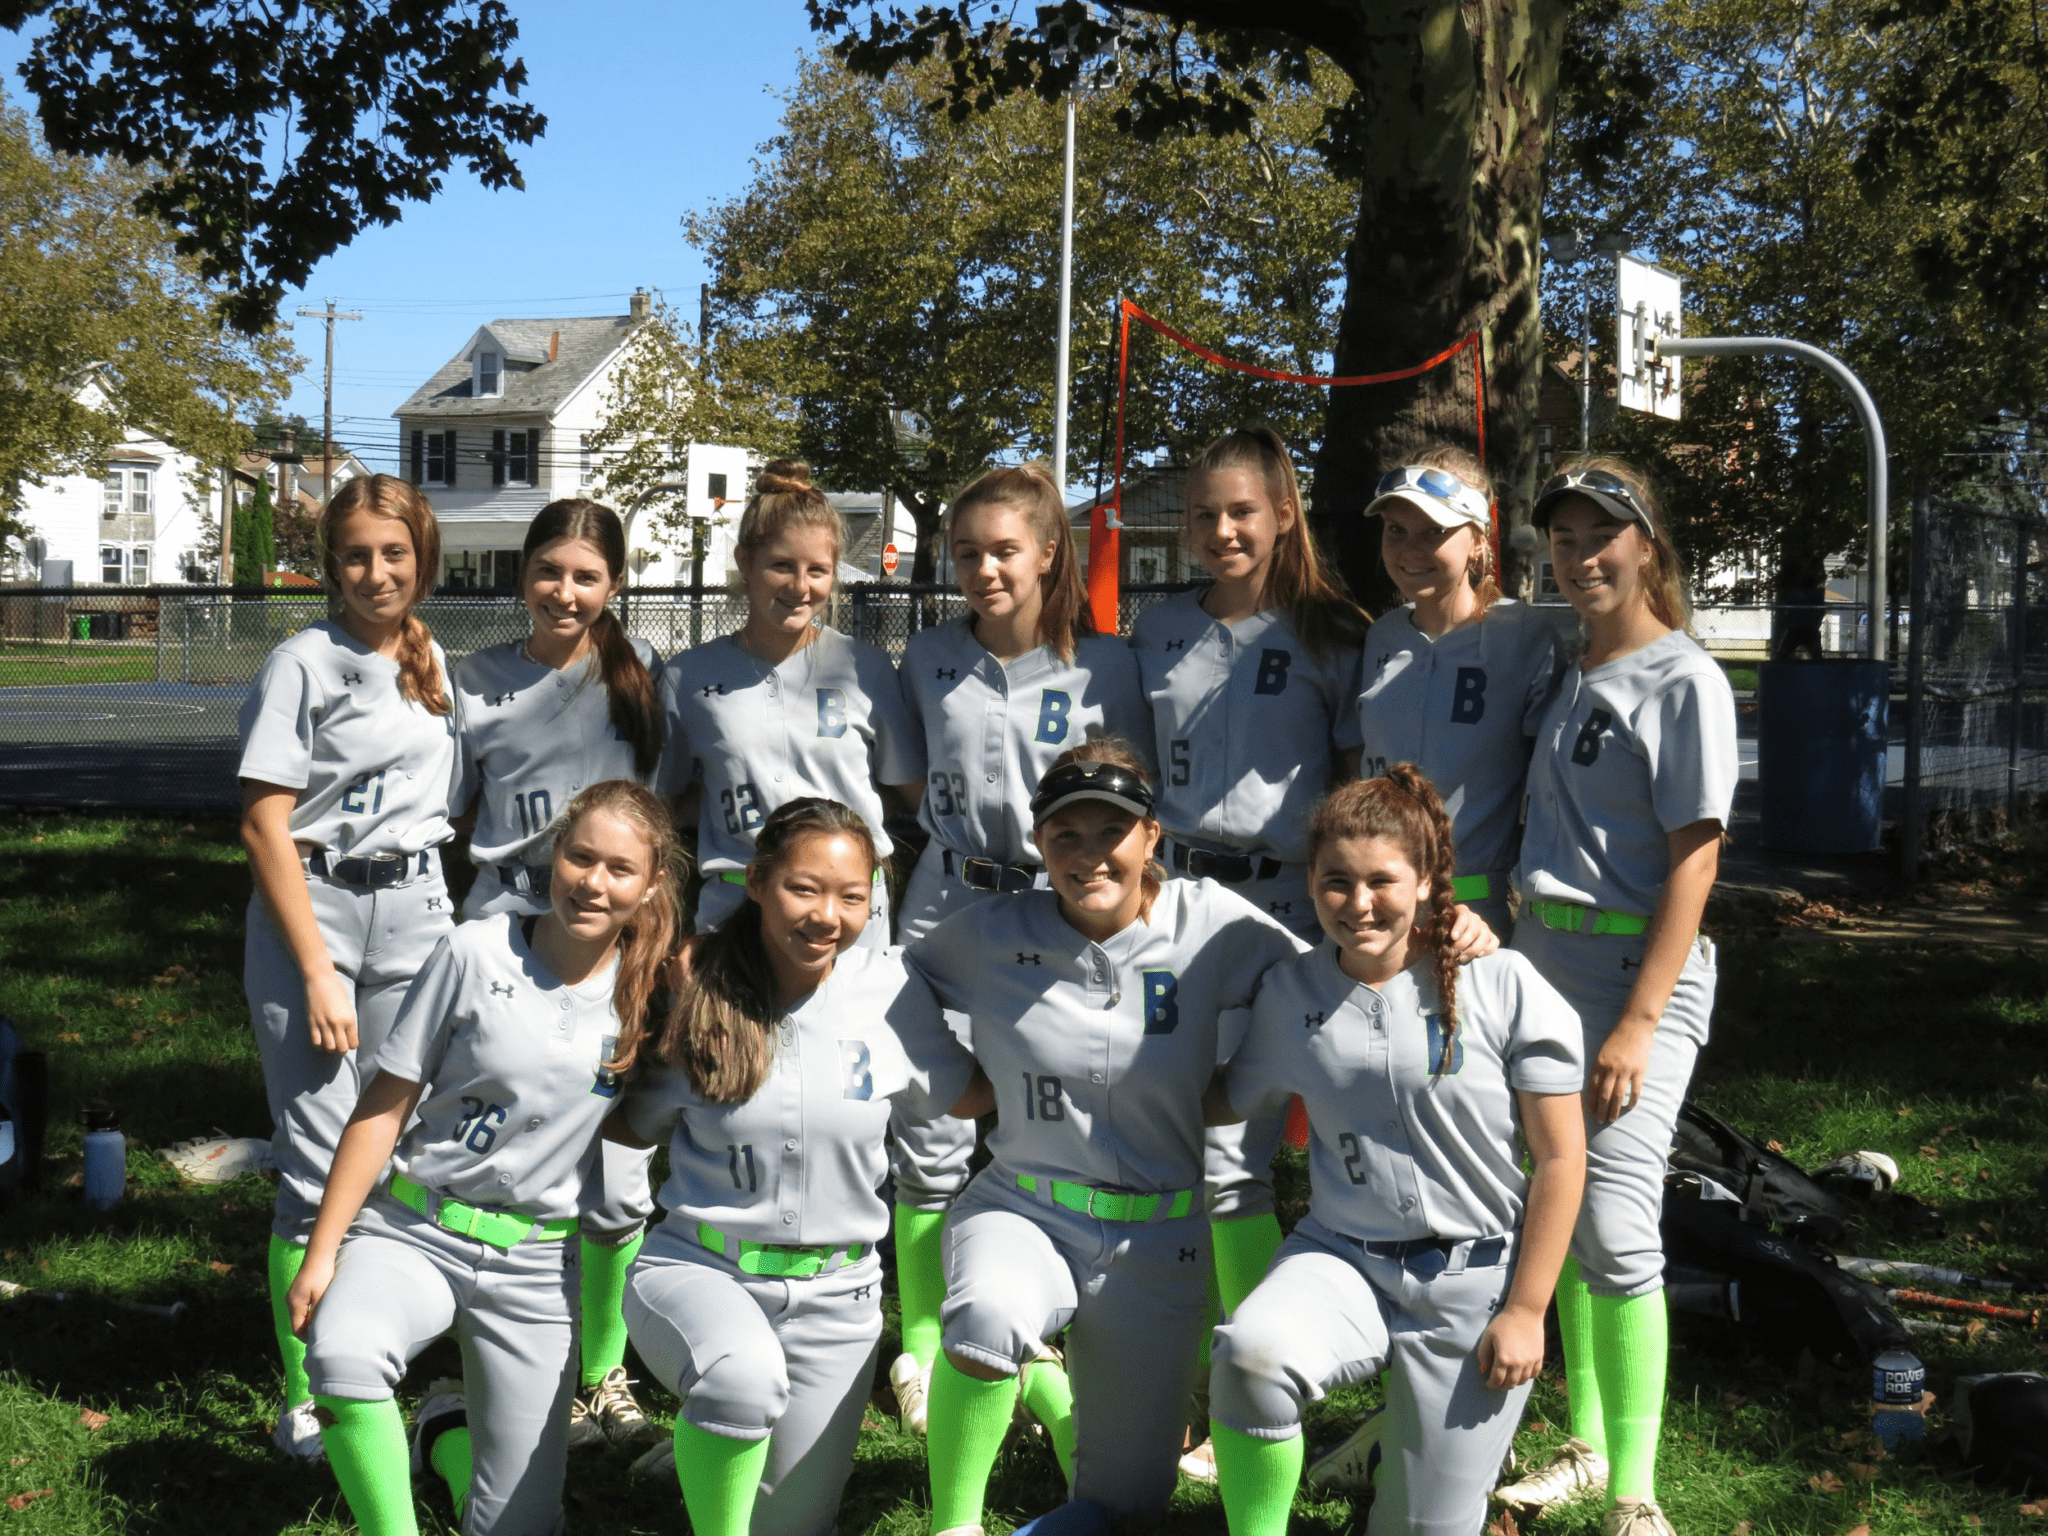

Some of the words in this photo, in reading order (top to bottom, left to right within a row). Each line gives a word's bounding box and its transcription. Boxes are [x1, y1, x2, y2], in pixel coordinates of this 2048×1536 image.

[884, 552, 898, 563] STOP
[1254, 648, 1292, 696] B
[1450, 666, 1488, 725] B
[816, 688, 848, 739] B
[1033, 687, 1072, 746] B
[1571, 708, 1612, 767] B
[341, 771, 386, 815] 21
[515, 789, 552, 839] 10
[720, 782, 764, 835] 22
[930, 771, 967, 817] 32
[1142, 970, 1179, 1035] B
[837, 1039, 873, 1101] B
[1425, 1014, 1465, 1077] B
[1022, 1072, 1065, 1122] 18
[452, 1095, 506, 1156] 36
[727, 1144, 757, 1193] 11
[1338, 1132, 1367, 1185] 2
